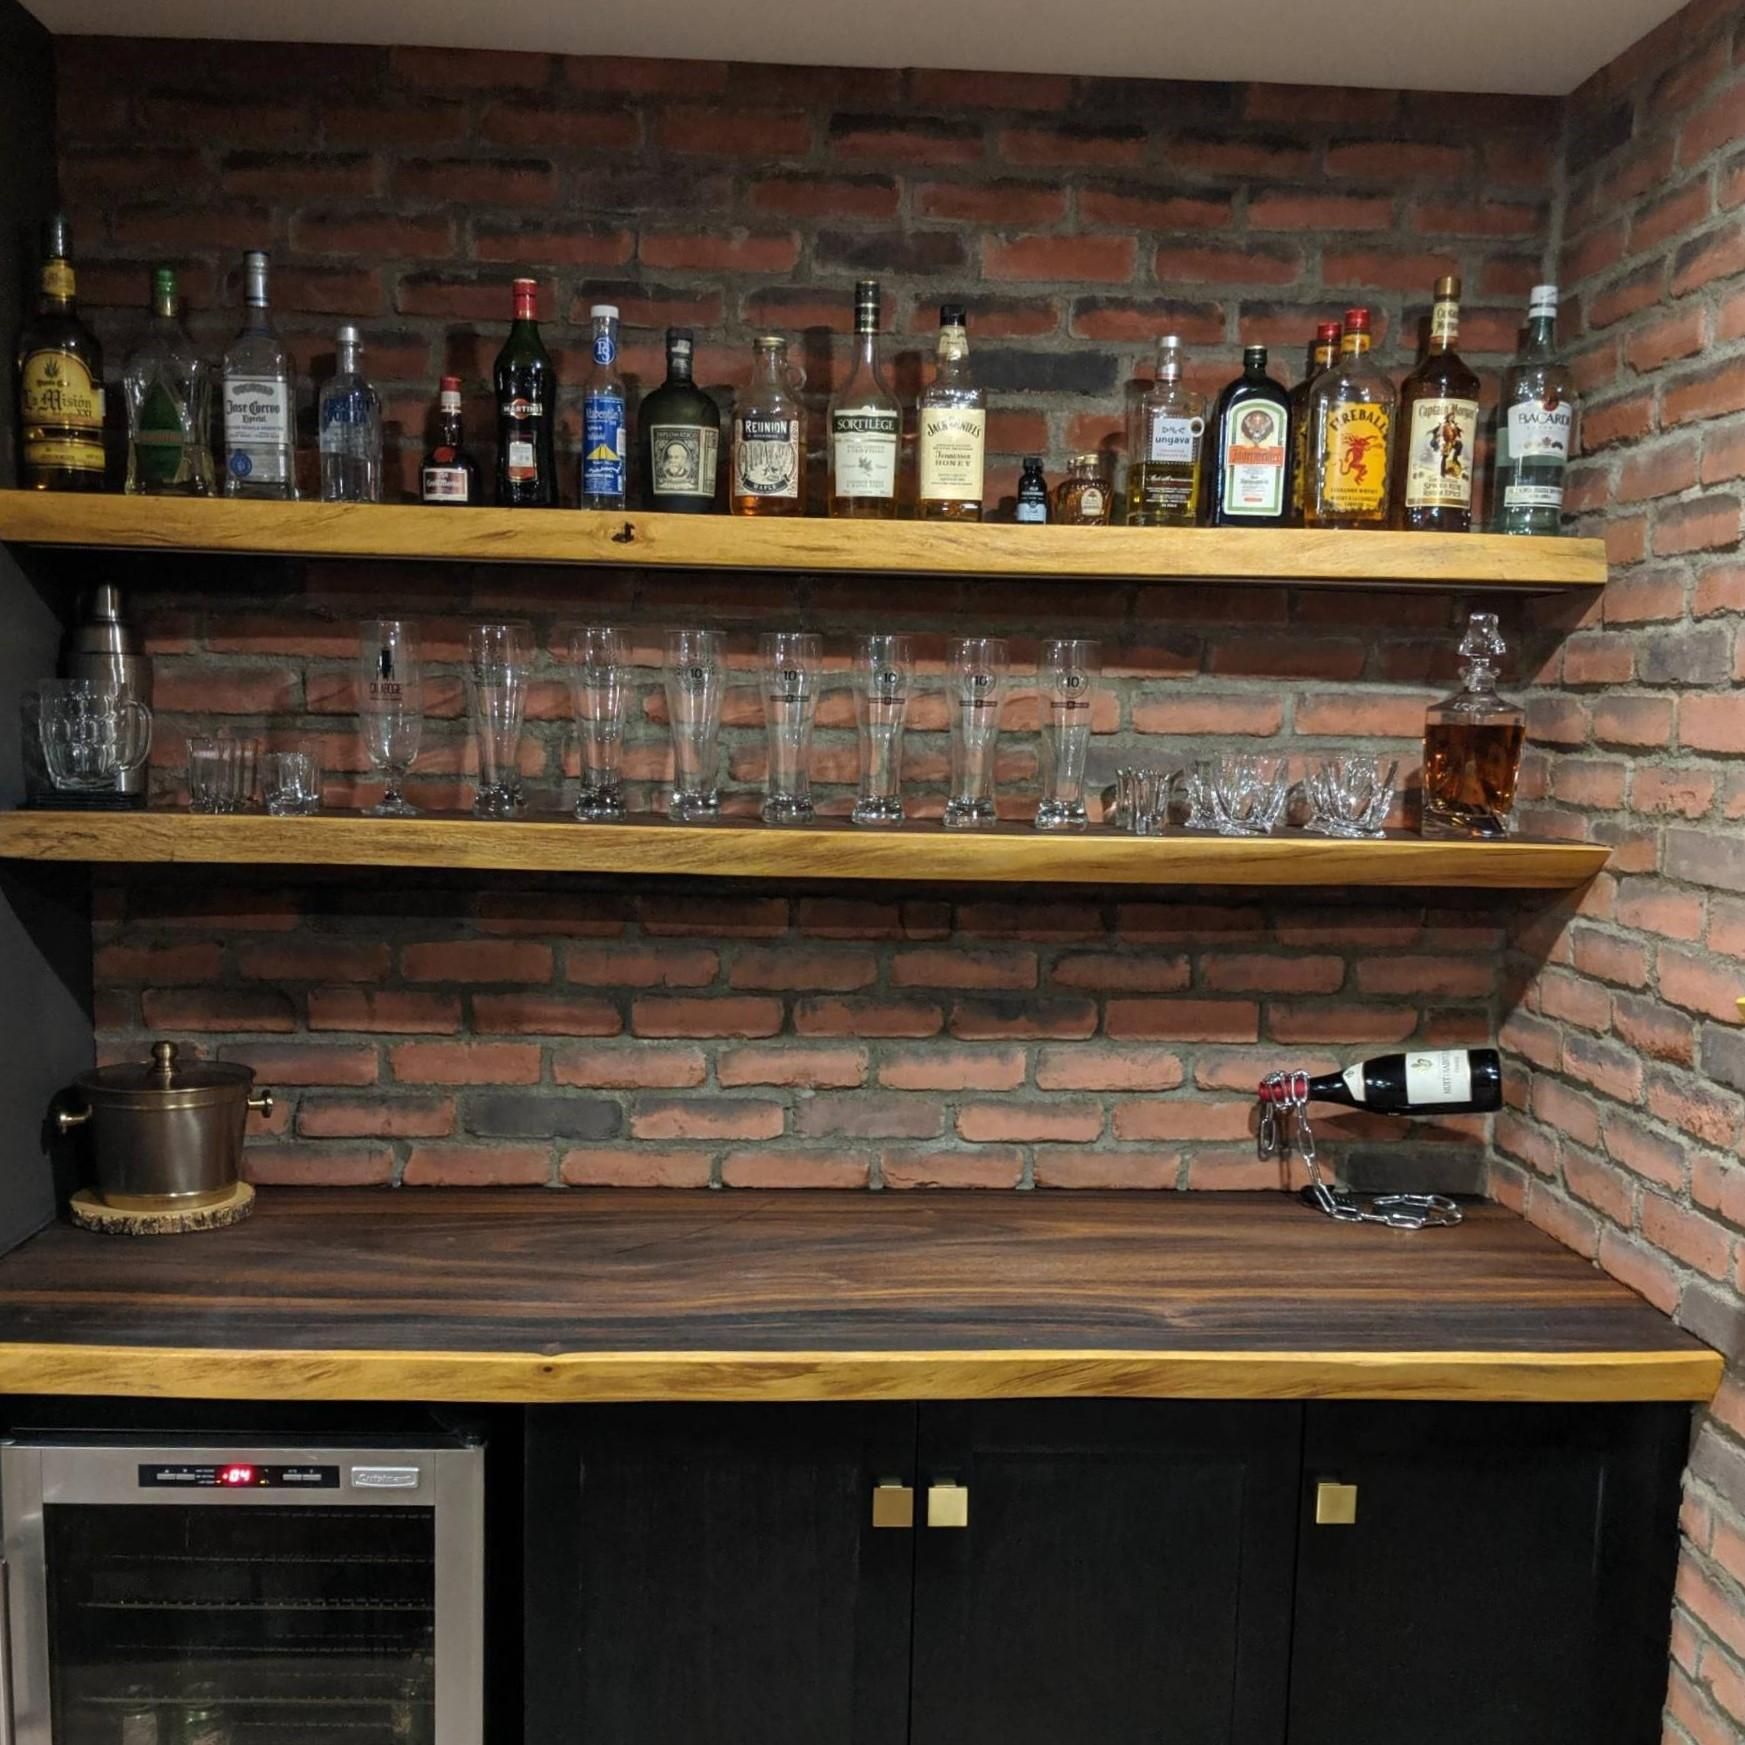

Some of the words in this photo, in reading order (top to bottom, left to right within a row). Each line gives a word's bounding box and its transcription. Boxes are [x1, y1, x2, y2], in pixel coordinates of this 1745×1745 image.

[1329, 408, 1388, 432] FIREBALL
[1518, 412, 1571, 425] BACARD
[745, 420, 787, 434] REUNION
[1155, 435, 1190, 446] ungava
[690, 668, 703, 679] 10
[784, 671, 797, 681] 10
[883, 672, 897, 683] 10
[974, 675, 988, 686] 10
[1066, 676, 1080, 687] 10
